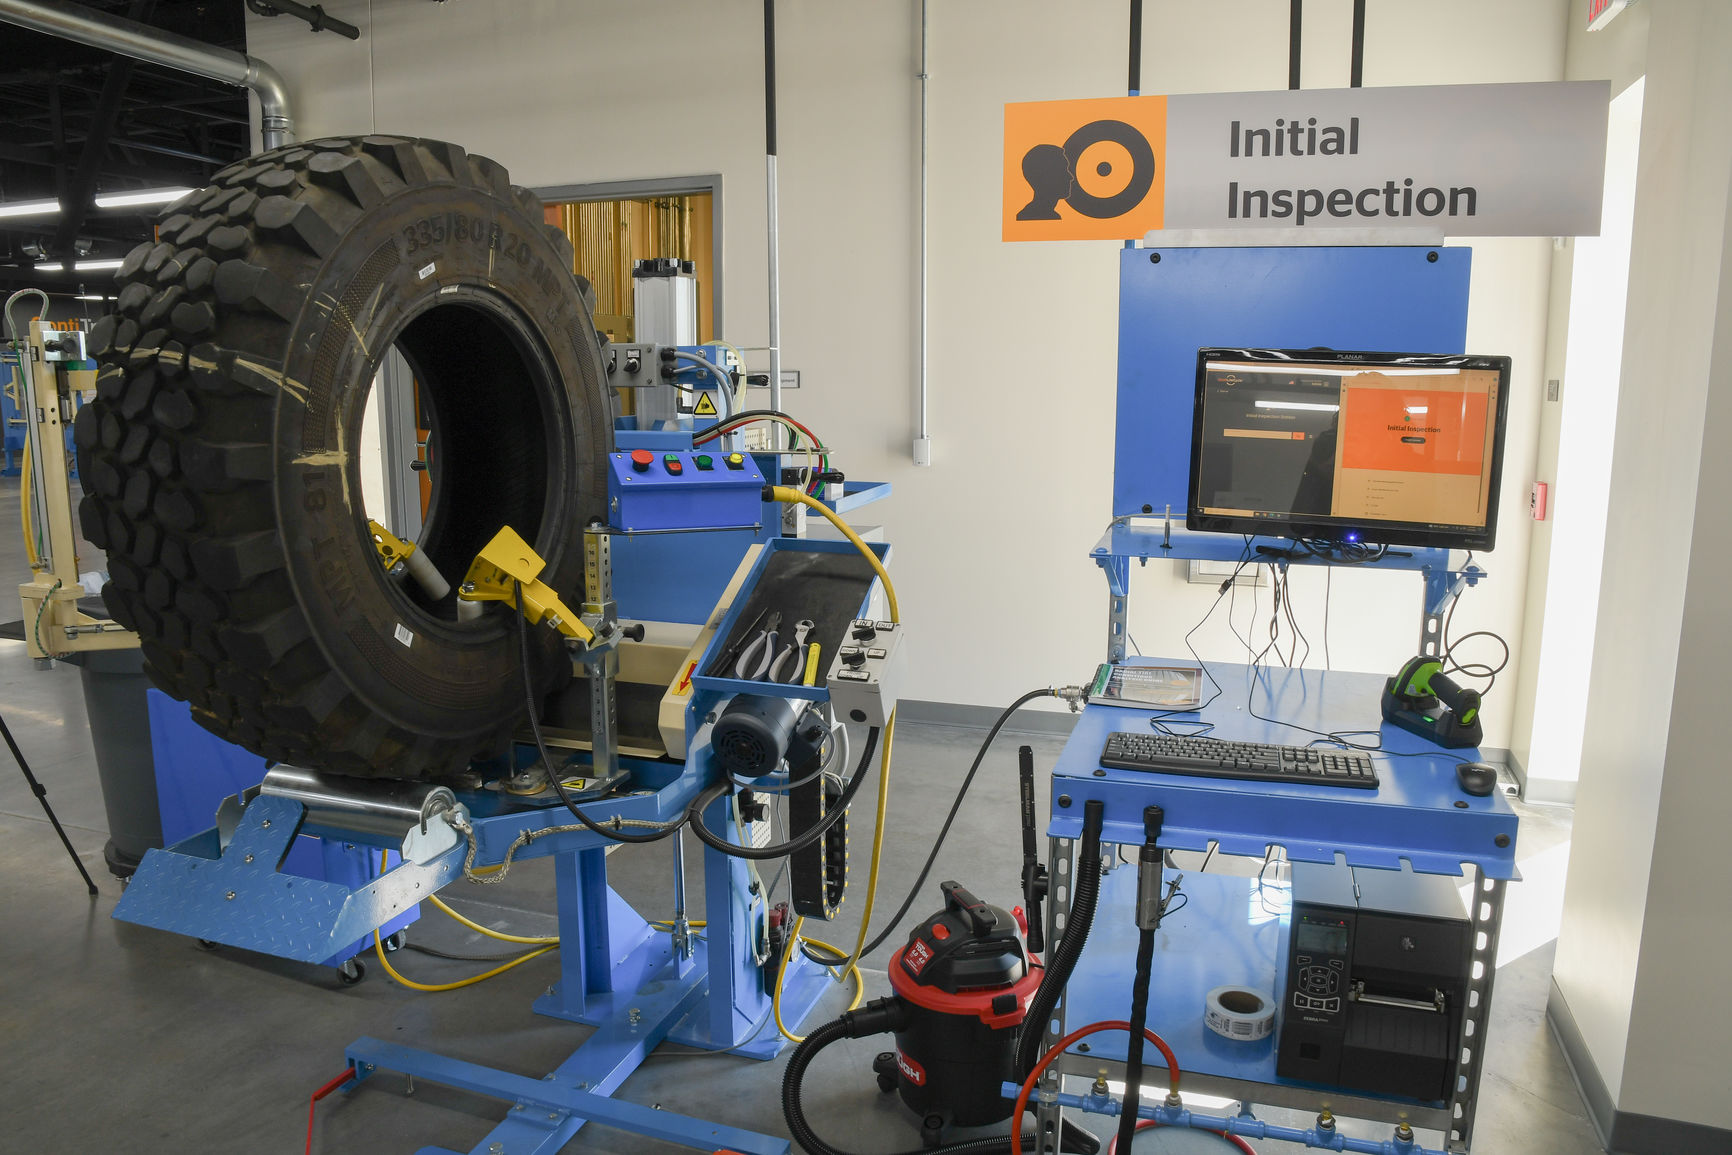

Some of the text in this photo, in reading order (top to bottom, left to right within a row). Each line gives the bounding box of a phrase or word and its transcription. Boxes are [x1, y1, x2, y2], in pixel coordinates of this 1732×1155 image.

[1230, 117, 1359, 157] Initial
[1228, 178, 1477, 226] Inspection
[402, 212, 485, 255] 335/80
[488, 221, 504, 250] R
[503, 232, 532, 268] 20
